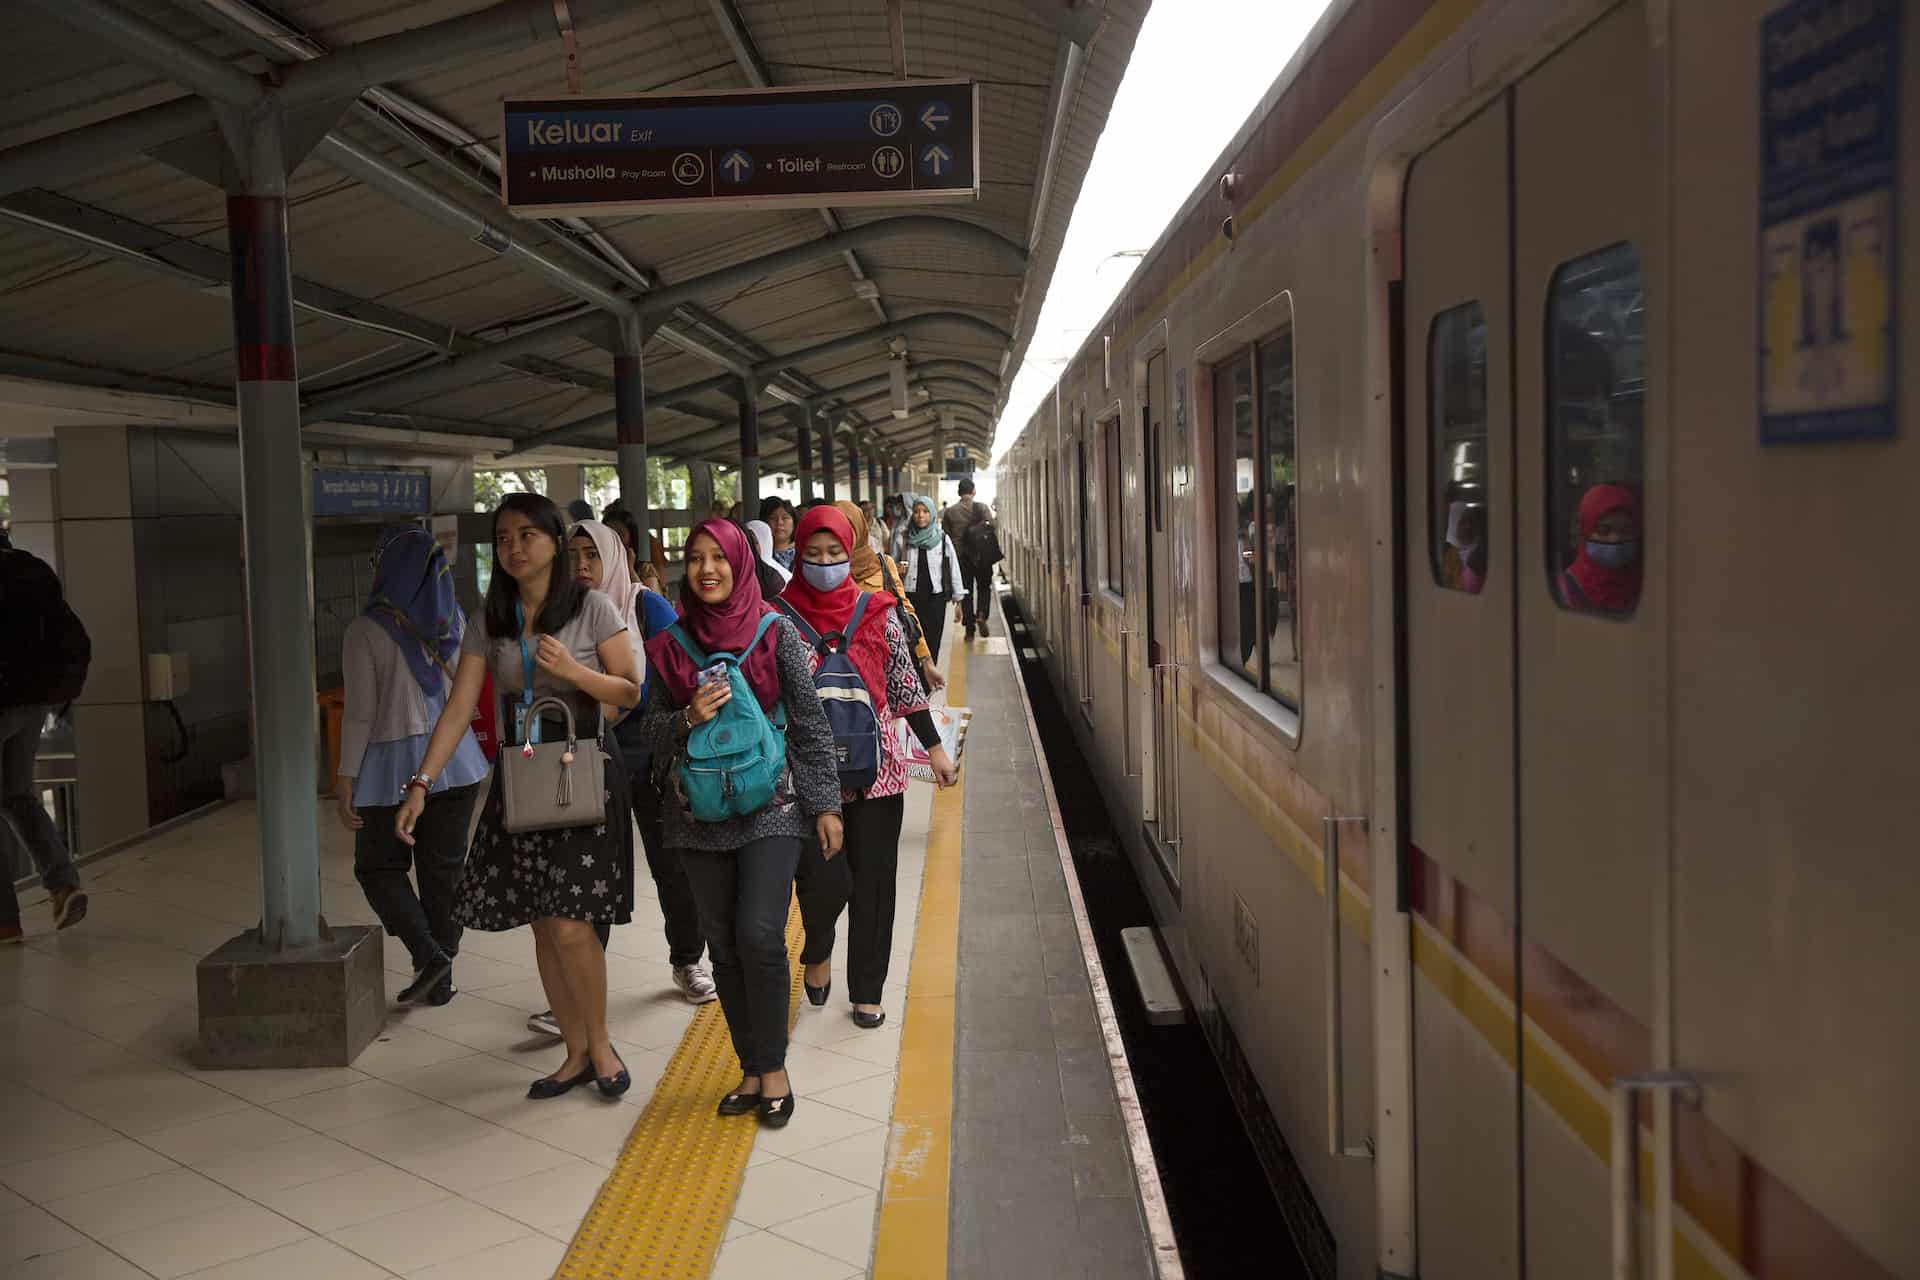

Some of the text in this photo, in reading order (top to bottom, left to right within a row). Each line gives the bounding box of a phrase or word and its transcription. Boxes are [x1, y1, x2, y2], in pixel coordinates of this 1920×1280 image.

[527, 119, 655, 145] Keluar Exit
[542, 165, 666, 181] Musholla Pray Room
[777, 156, 820, 173] Toilet
